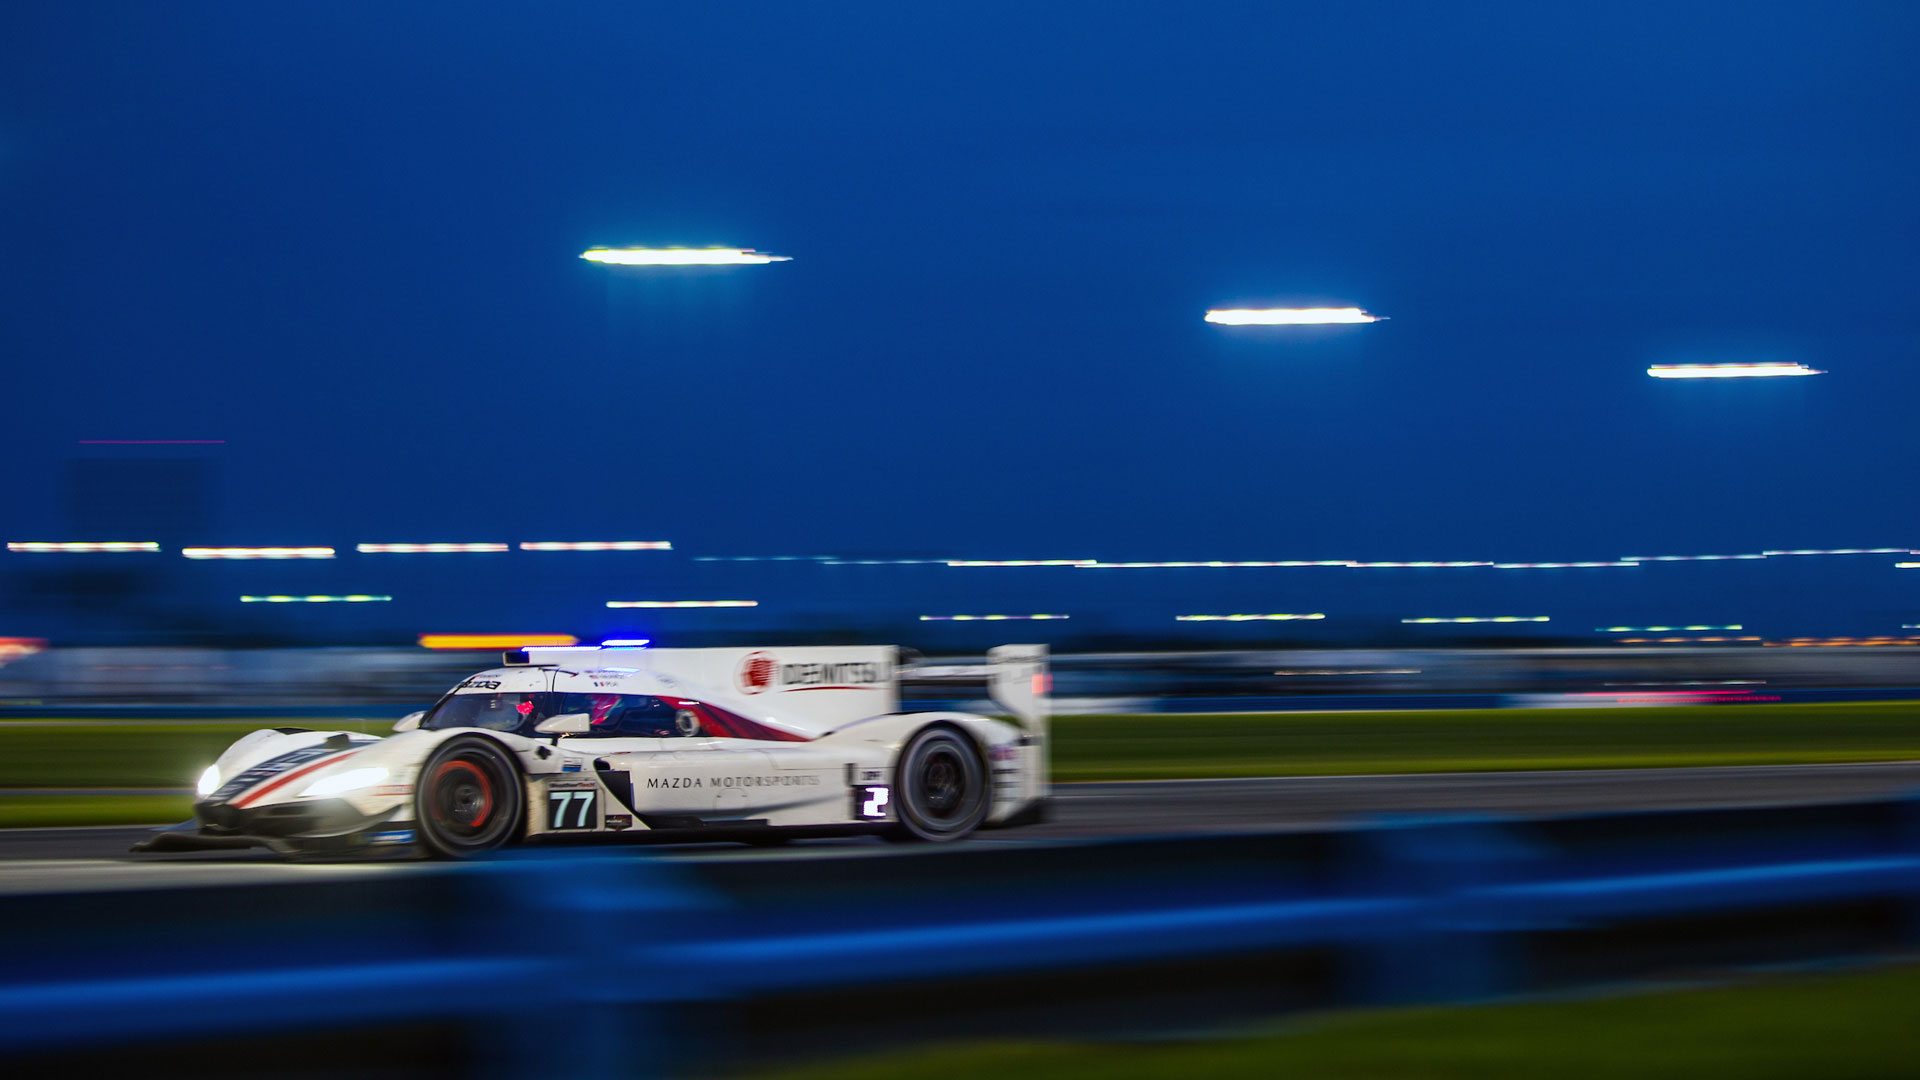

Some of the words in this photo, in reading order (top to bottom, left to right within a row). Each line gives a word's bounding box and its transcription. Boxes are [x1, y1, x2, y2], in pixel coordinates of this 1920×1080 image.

[647, 778, 702, 788] MAZDA
[550, 791, 595, 828] 77
[863, 787, 889, 817] 2
